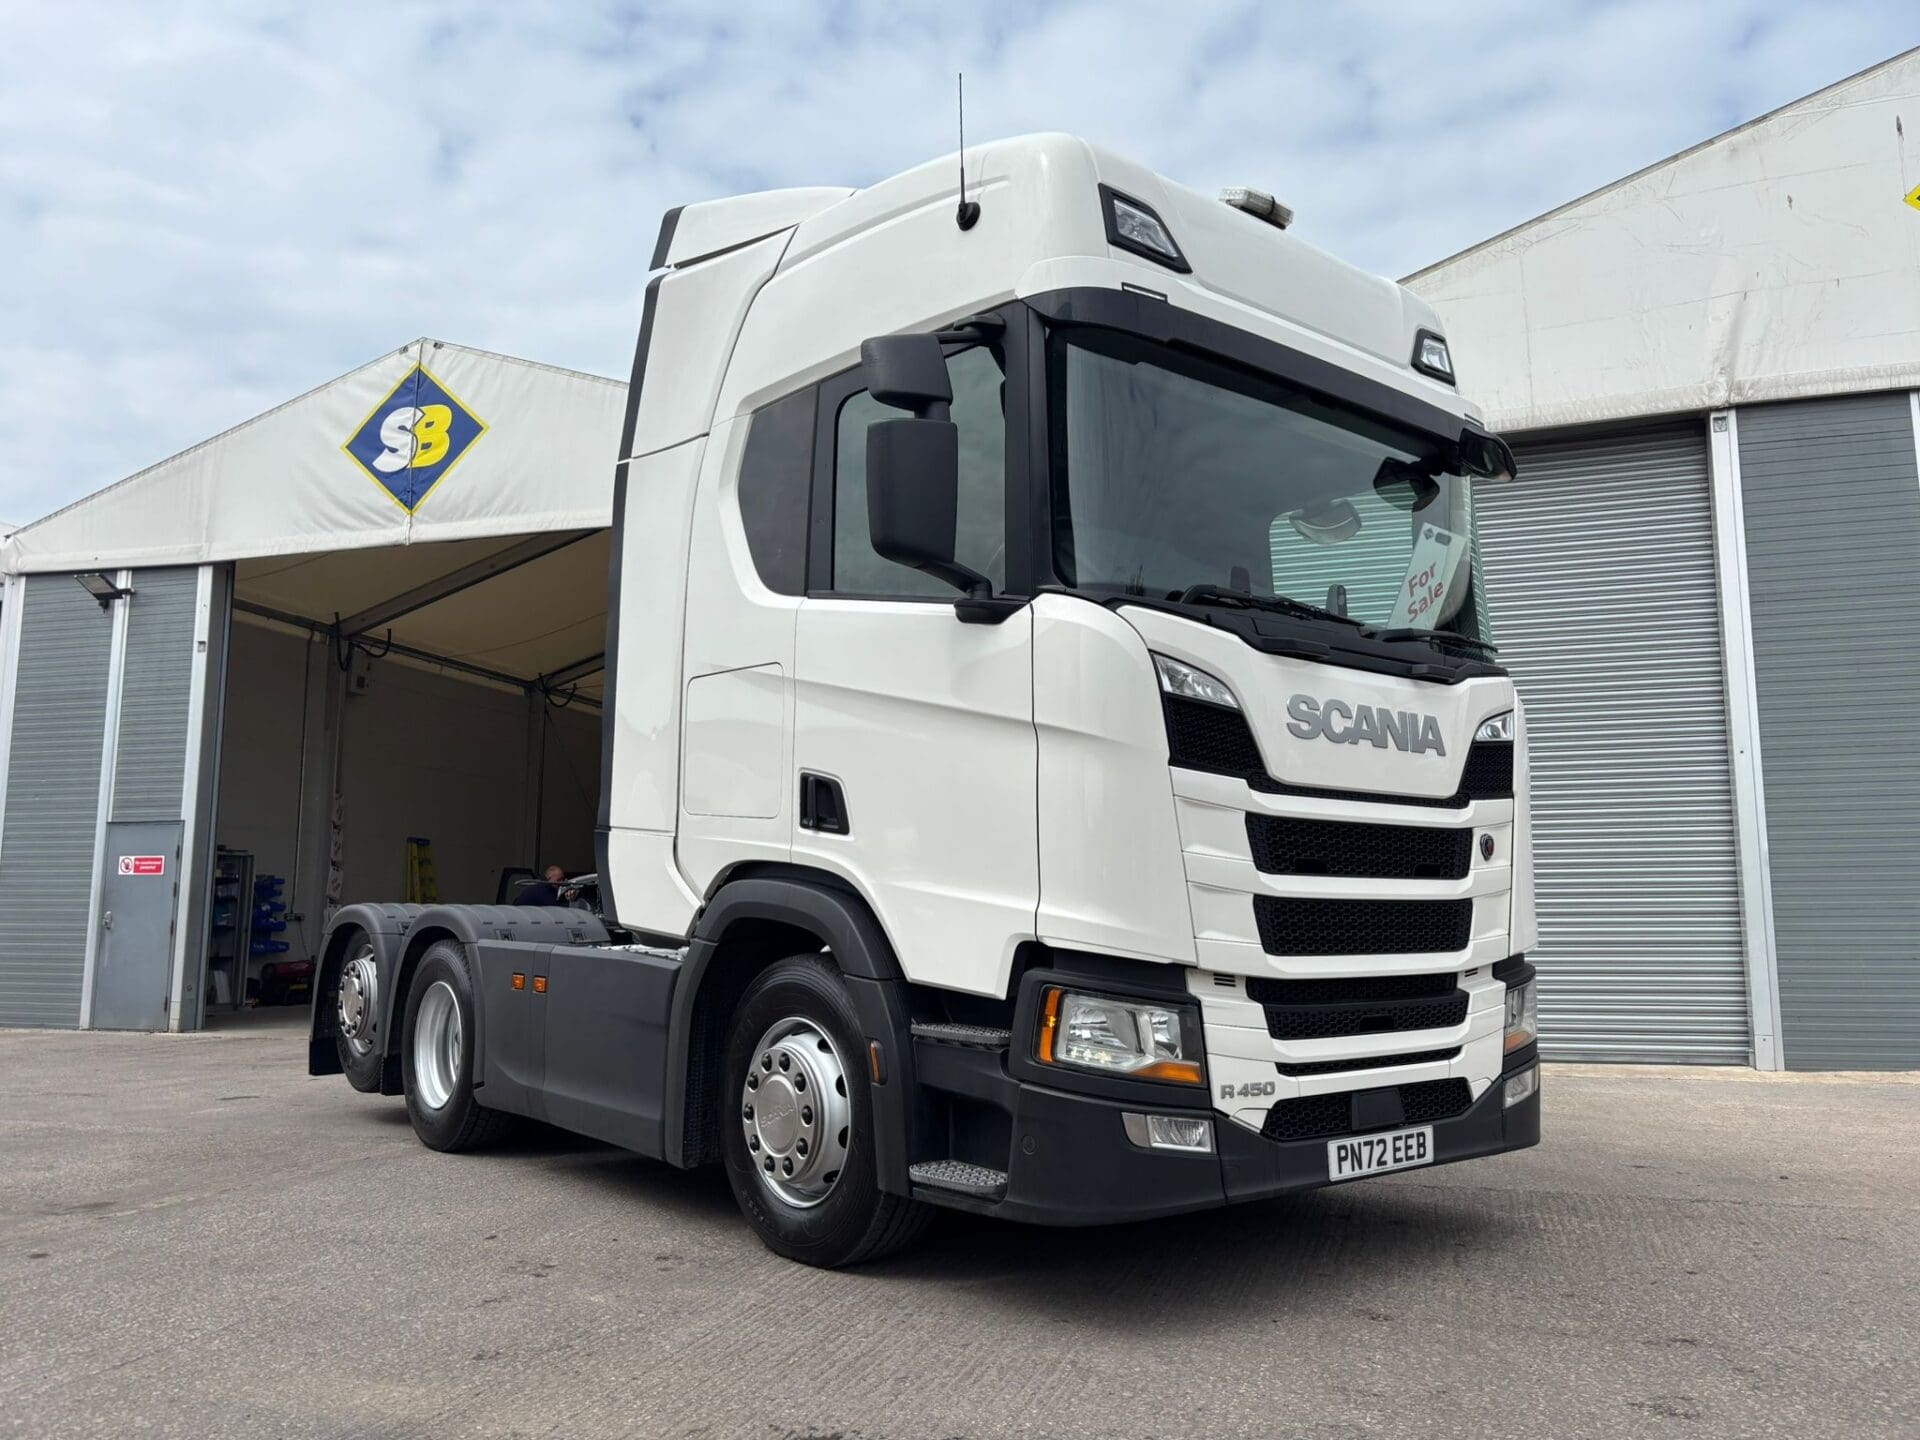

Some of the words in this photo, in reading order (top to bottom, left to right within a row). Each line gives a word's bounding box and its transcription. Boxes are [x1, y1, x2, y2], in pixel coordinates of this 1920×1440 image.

[372, 404, 453, 473] SB
[1408, 562, 1437, 598] For
[1407, 582, 1444, 624] Sale
[1286, 694, 1446, 757] SCANIA
[1220, 1084, 1235, 1099] R
[1237, 1081, 1276, 1097] 450
[1337, 1138, 1388, 1174] PN72
[1392, 1131, 1427, 1164] EEB
